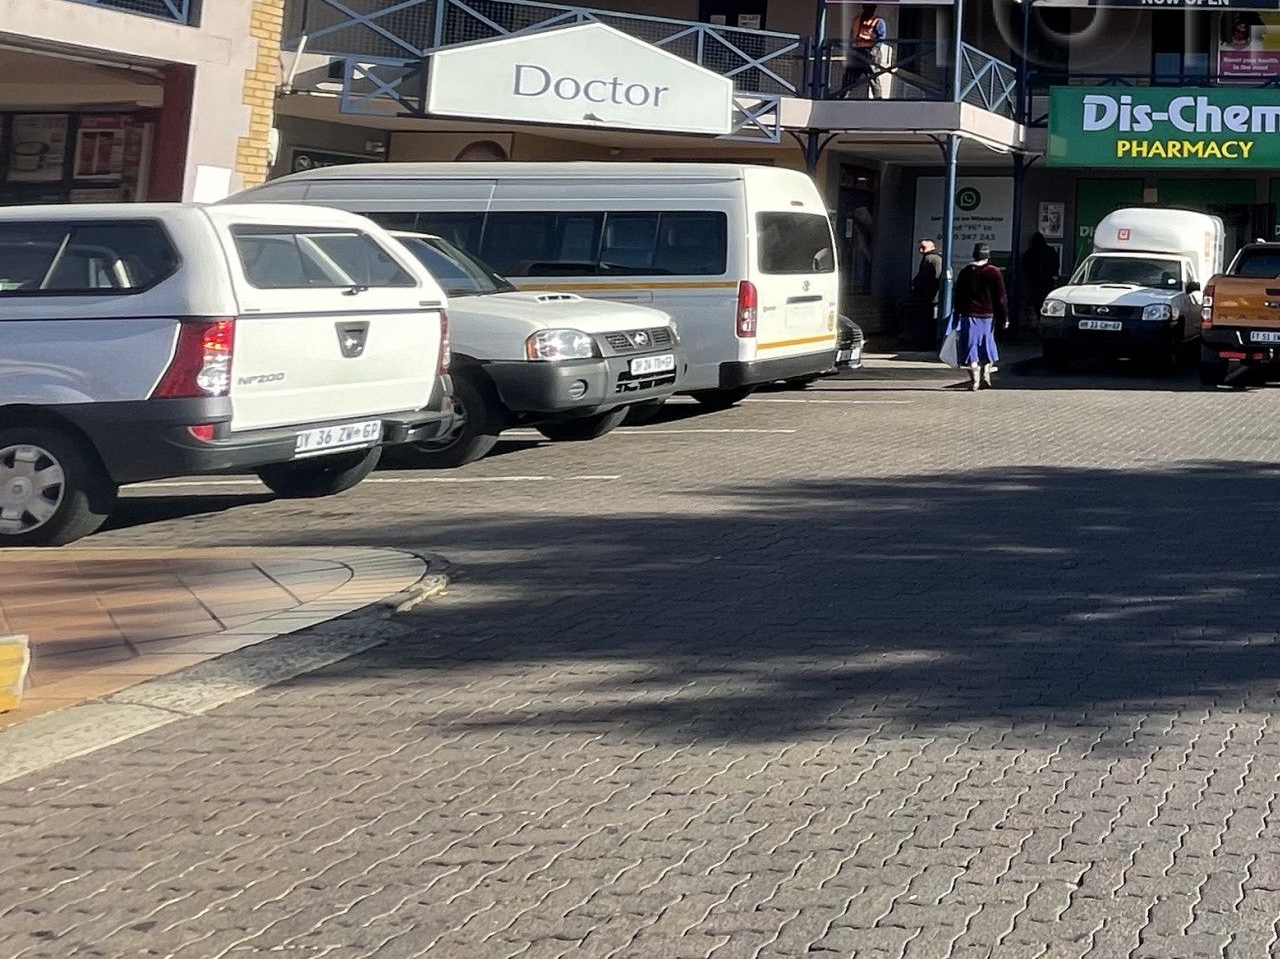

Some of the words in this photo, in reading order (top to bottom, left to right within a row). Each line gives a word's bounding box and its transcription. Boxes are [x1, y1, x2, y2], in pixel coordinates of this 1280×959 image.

[513, 63, 669, 108] Doctor
[1116, 139, 1254, 159] PHARMACY
[238, 372, 285, 386] NP200
[317, 429, 332, 446] 36
[362, 422, 379, 439] GP
